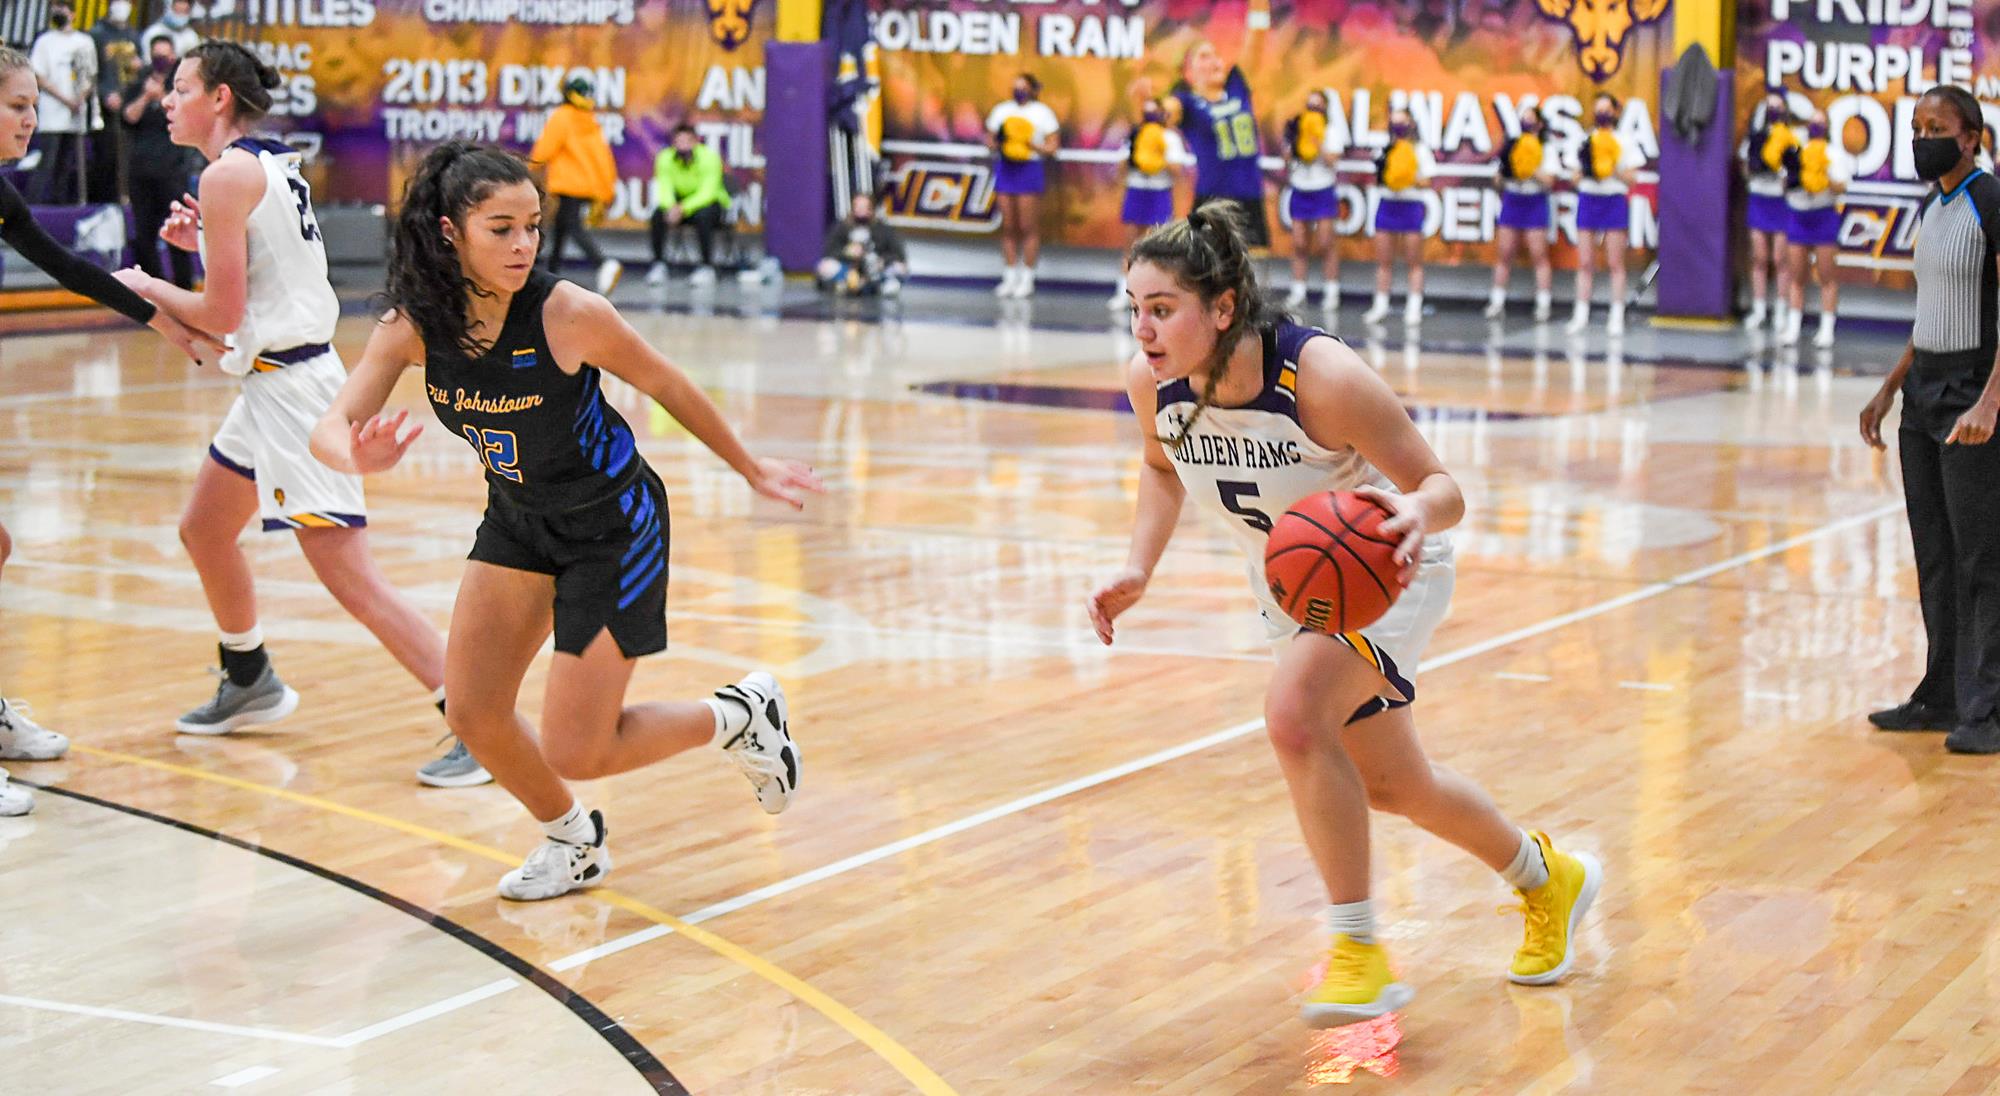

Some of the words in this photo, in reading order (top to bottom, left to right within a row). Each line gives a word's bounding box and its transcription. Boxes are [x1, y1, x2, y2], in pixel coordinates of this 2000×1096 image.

[1038, 14, 1145, 58] RAM
[1770, 0, 1974, 28] RIDE
[382, 59, 488, 104] 2013
[1766, 40, 1973, 96] PURPLE
[383, 107, 506, 143] TROPHY
[1614, 97, 1661, 159] A
[453, 387, 544, 414] Johnstown
[462, 423, 523, 484] 12
[1242, 437, 1302, 469] RAMS
[1215, 479, 1275, 535] 5
